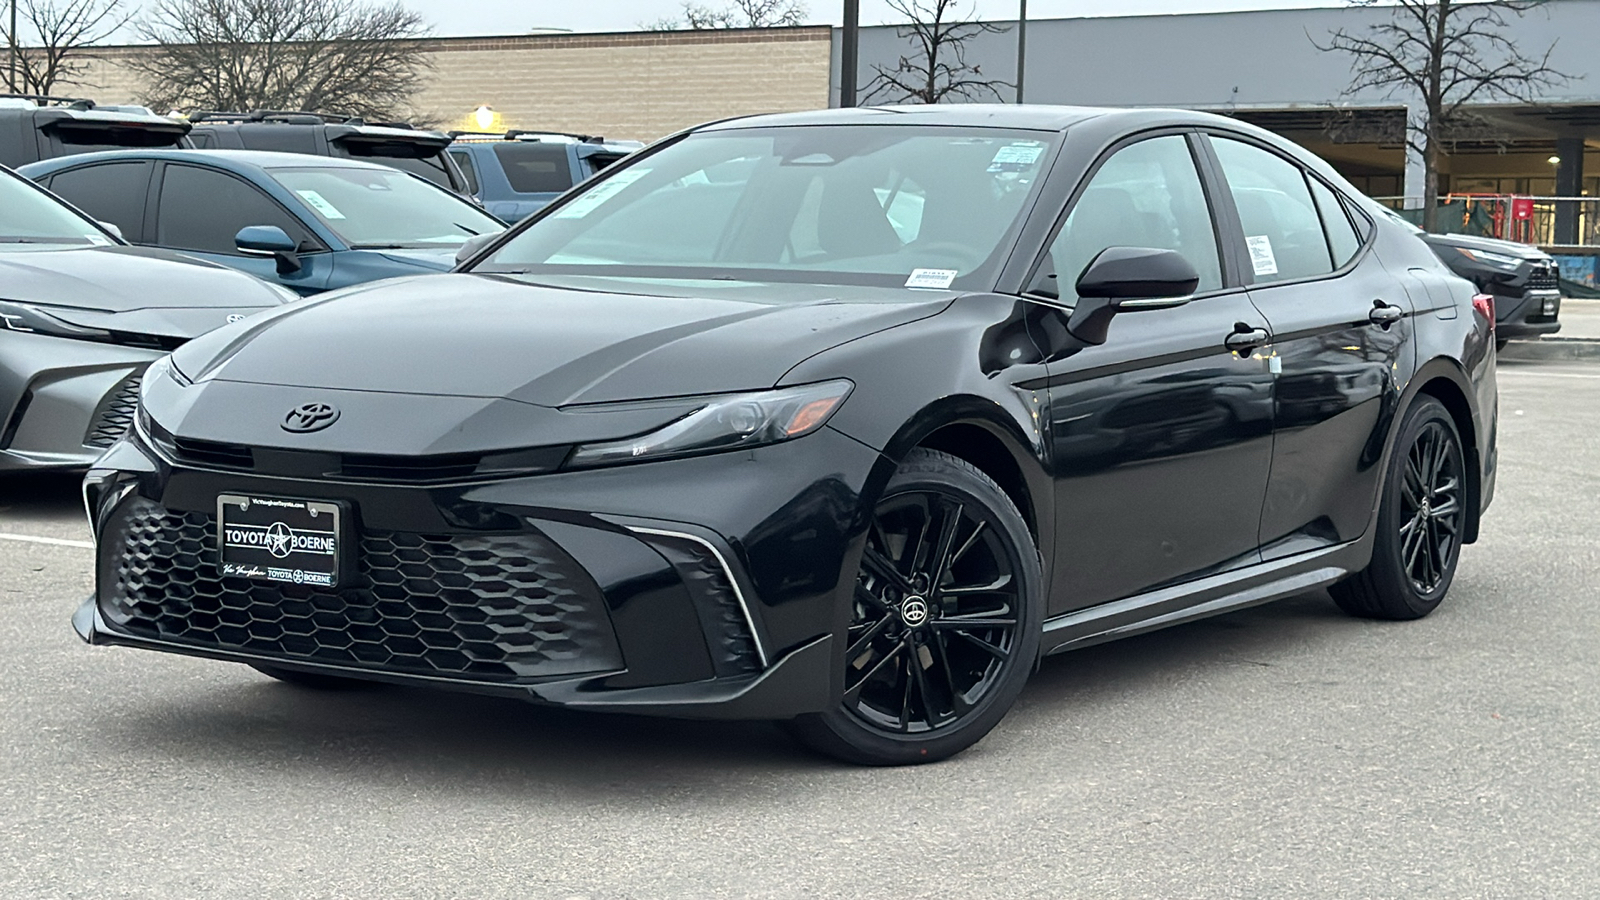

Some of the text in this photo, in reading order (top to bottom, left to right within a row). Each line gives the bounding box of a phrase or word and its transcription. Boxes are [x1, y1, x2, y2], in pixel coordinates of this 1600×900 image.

[225, 530, 335, 550] TOYOTA BOERNE
[267, 570, 331, 583] TOYOTA BOERNE
